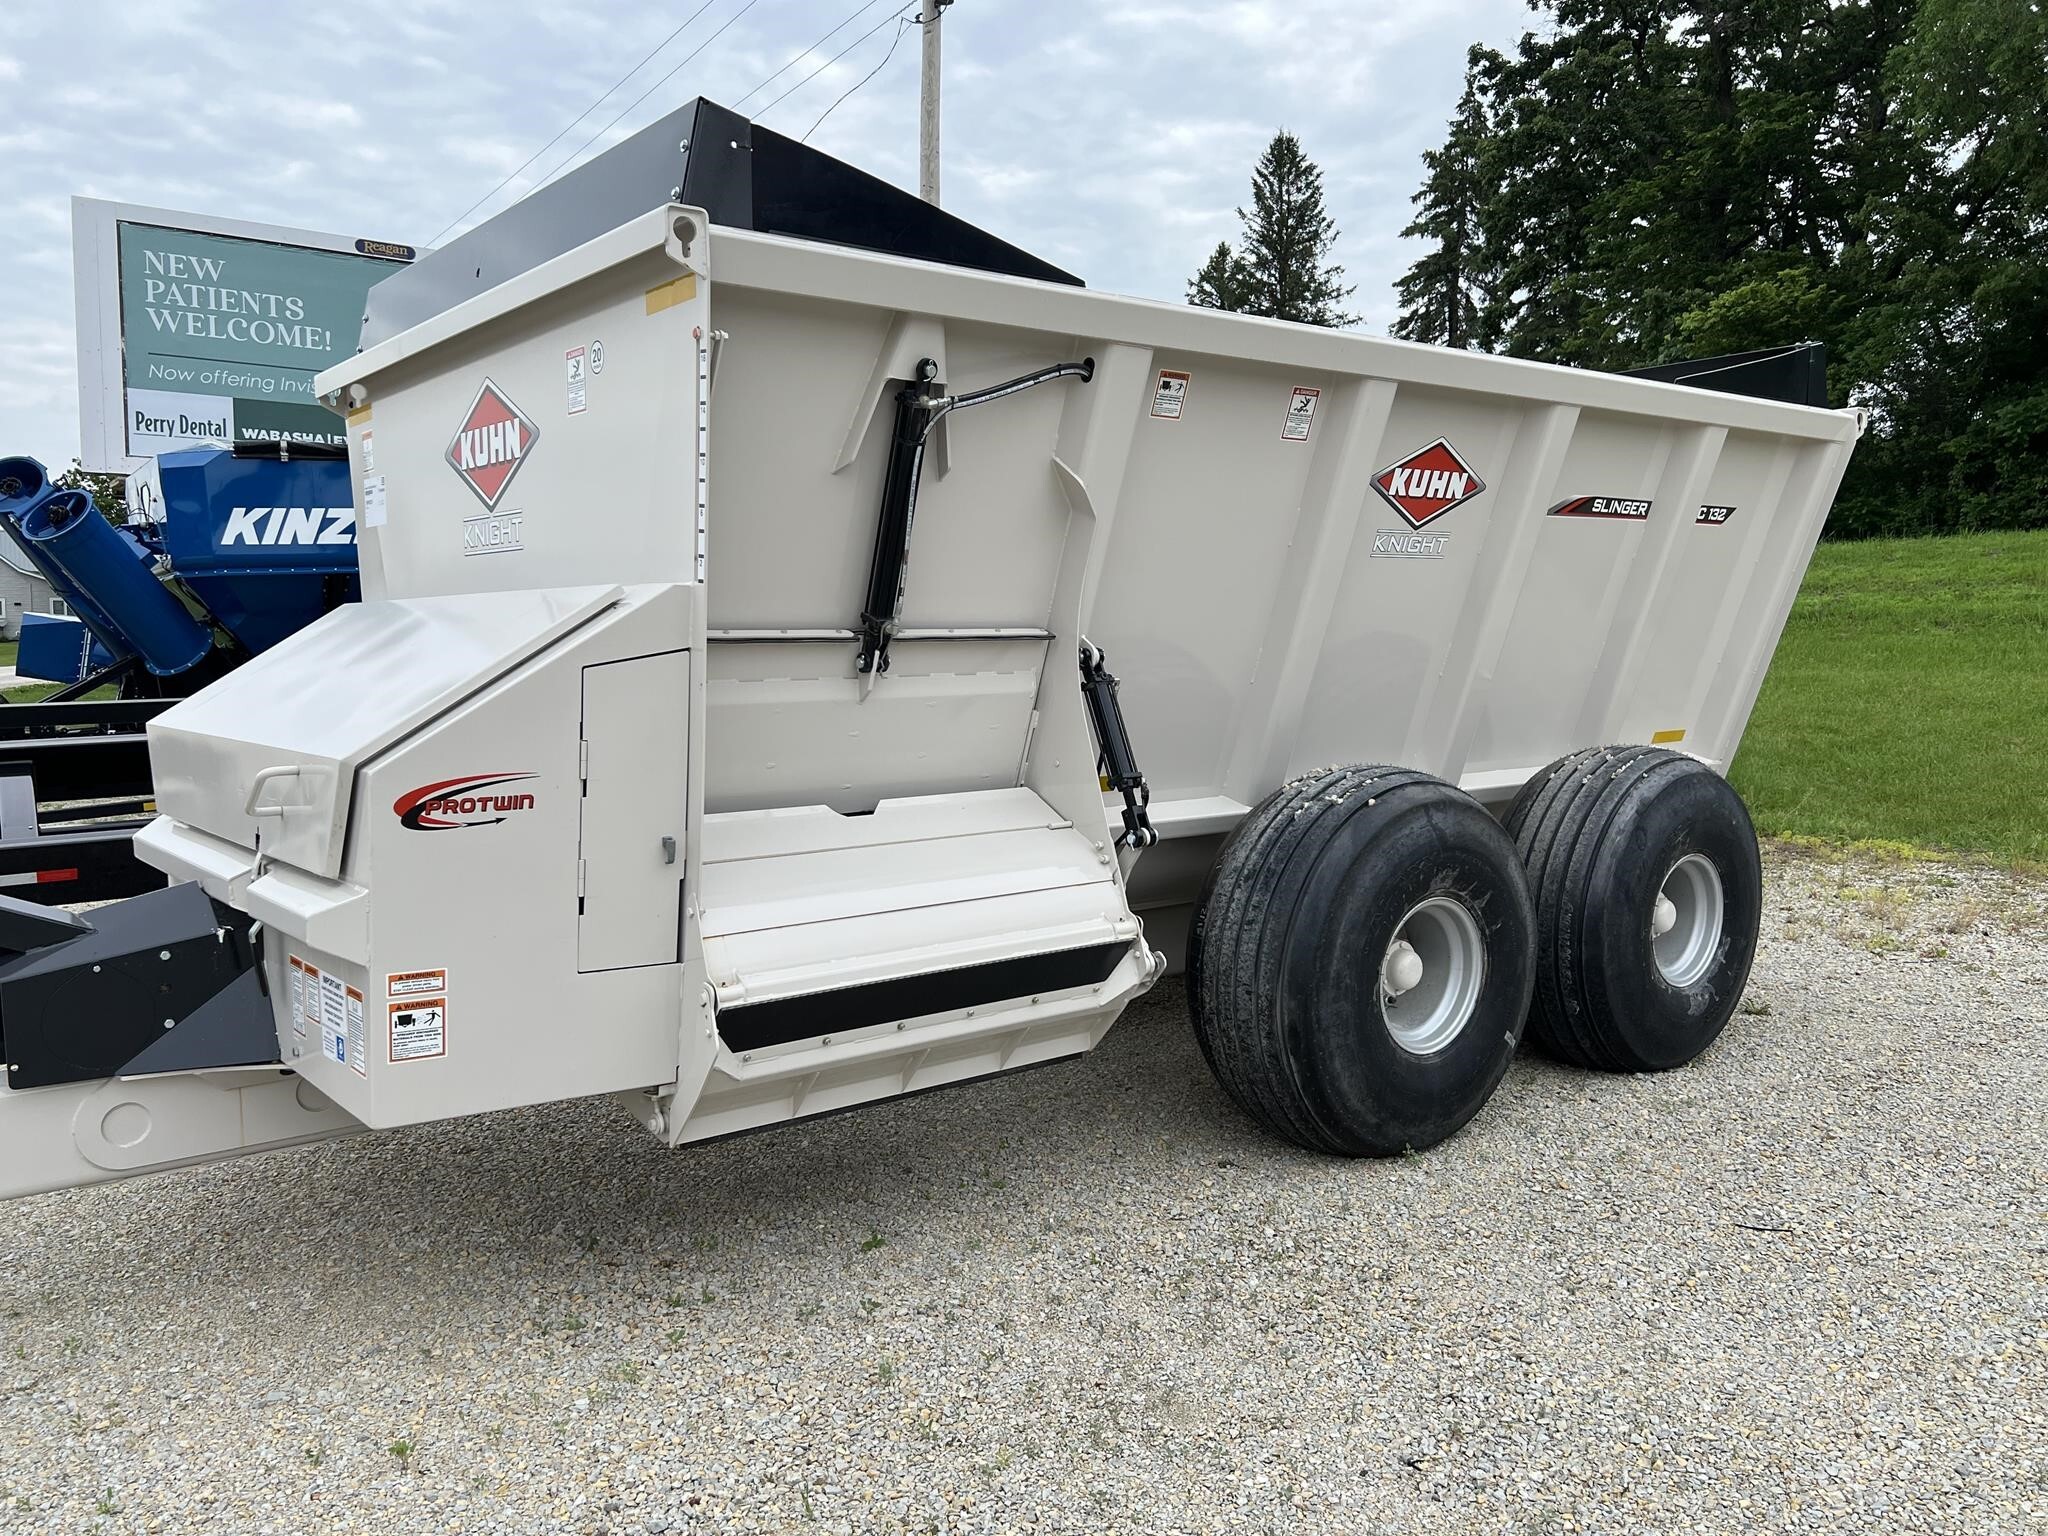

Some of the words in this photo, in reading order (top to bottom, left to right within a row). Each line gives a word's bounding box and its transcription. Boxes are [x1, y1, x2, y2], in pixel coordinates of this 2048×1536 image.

[363, 241, 408, 255] Reagan
[143, 250, 226, 282] NEW
[144, 278, 305, 320] PATIENTS
[145, 307, 332, 351] WELCOME!
[592, 347, 602, 363] 20
[148, 364, 195, 381] Now
[200, 370, 274, 393] offering
[135, 410, 175, 437] Perry
[179, 414, 227, 437] Dental
[241, 427, 325, 443] WABASHA
[460, 418, 521, 471] KUHN
[1387, 467, 1469, 500] KUHN
[1591, 499, 1648, 516] SLINGER
[1708, 508, 1726, 521] 132
[464, 517, 523, 549] KNIGHT
[1372, 534, 1450, 554] KNIGHT
[424, 794, 535, 815] PROTWIN
[404, 970, 436, 980] WARNING
[404, 1000, 439, 1009] WARNING
